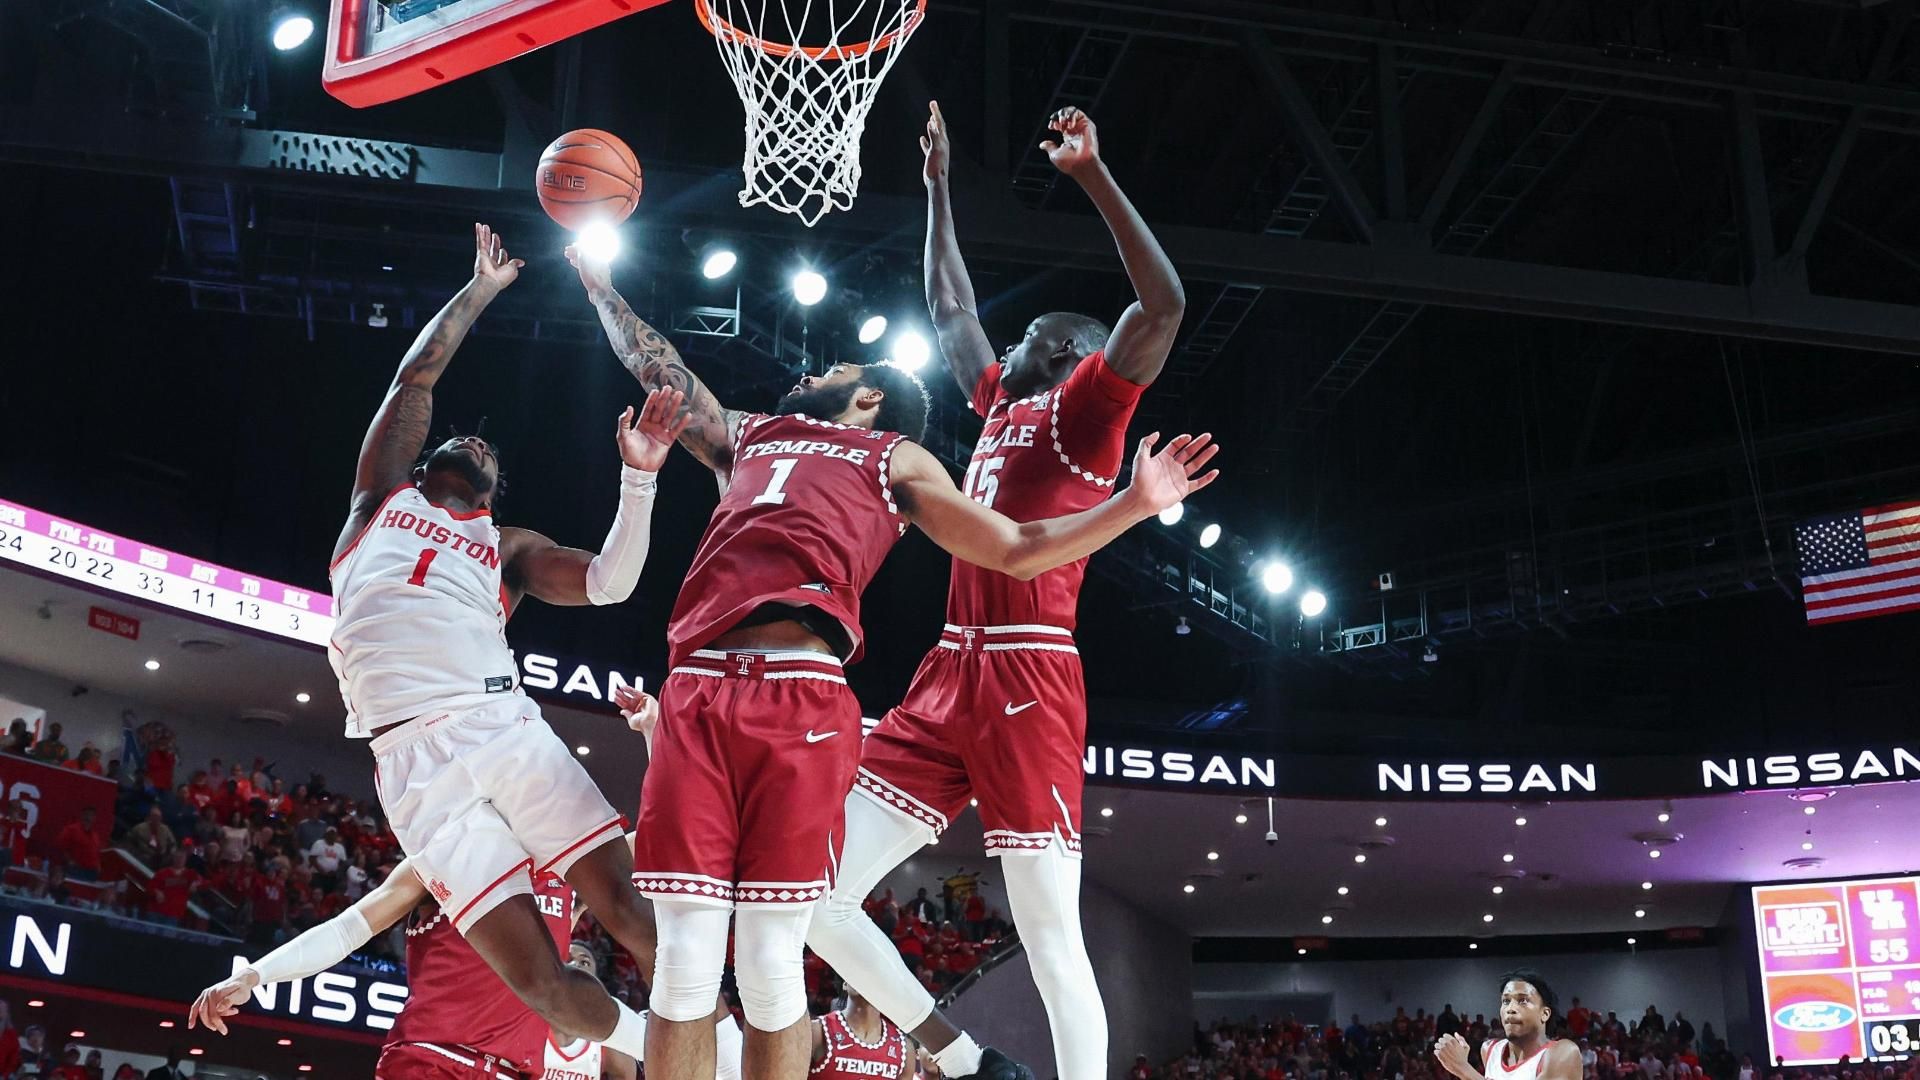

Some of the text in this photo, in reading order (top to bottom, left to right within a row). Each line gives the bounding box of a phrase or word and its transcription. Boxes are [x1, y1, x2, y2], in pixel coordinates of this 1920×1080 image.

[742, 440, 870, 466] TEMPLE
[751, 458, 799, 506] 1
[965, 456, 1006, 508] 15
[381, 509, 500, 570] HOUSTON
[407, 548, 438, 587] 1
[137, 572, 164, 594] 33
[192, 588, 215, 609] 11
[236, 600, 260, 620] 13
[289, 614, 300, 631] 3
[510, 648, 644, 703] SAN
[1378, 762, 1598, 793] NISSAN
[1870, 938, 1909, 963] 55
[834, 1056, 898, 1079] TEMPLE
